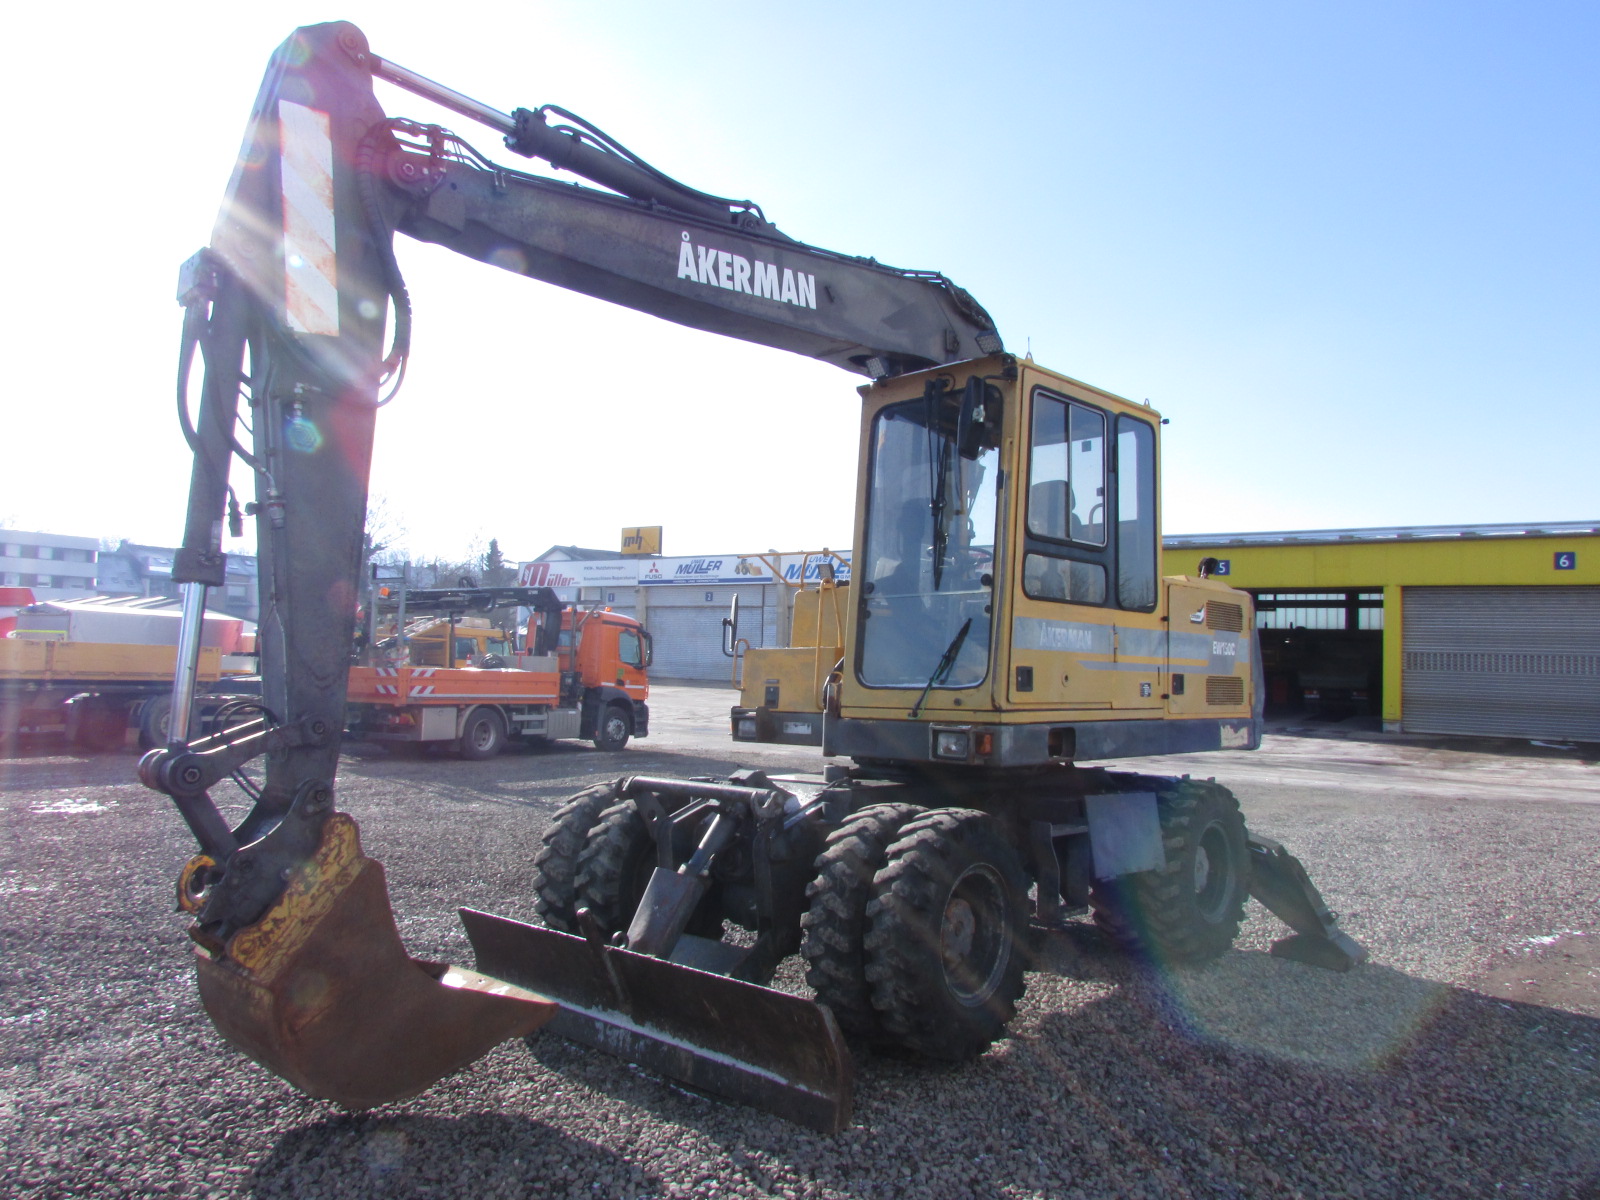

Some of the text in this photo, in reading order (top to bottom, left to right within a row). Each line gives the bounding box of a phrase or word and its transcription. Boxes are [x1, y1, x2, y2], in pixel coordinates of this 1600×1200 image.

[677, 231, 817, 310] ÅKERMAN
[1218, 562, 1226, 573] 5
[1559, 554, 1569, 567] 6
[1040, 622, 1092, 649] ÅKERMAN
